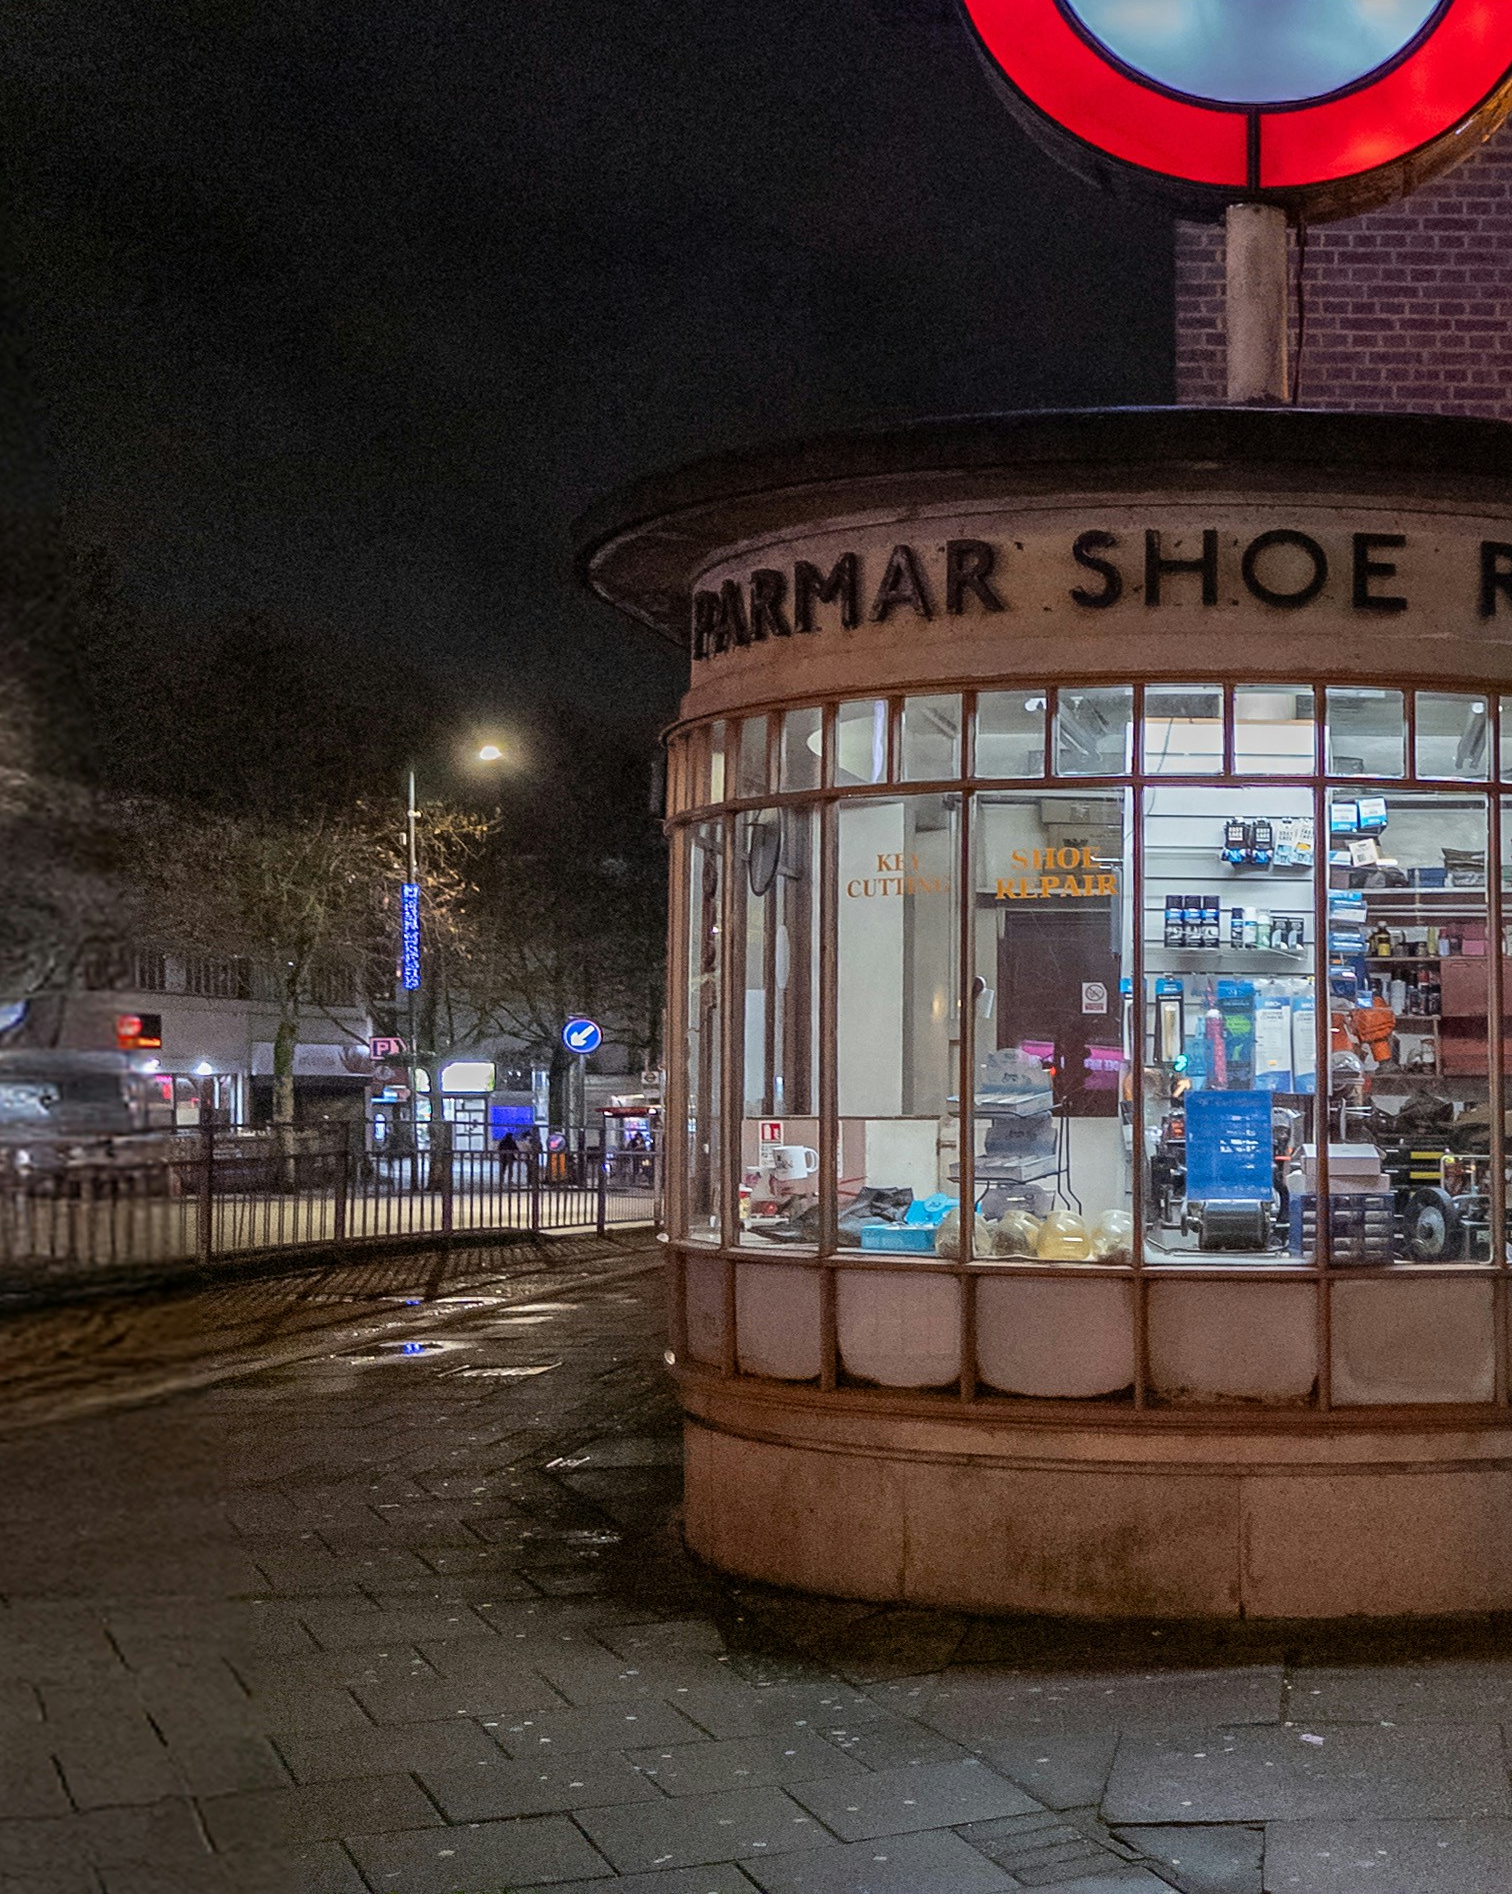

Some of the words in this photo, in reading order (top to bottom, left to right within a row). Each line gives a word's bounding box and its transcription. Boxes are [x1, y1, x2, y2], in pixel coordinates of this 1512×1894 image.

[693, 538, 1005, 661] PARMAR
[1071, 529, 1408, 612] SHOE
[877, 852, 920, 873] KEY
[1011, 846, 1101, 871] SHOE
[847, 874, 951, 899] CUTTING
[994, 872, 1118, 901] REPAIR
[377, 1042, 390, 1056] P
